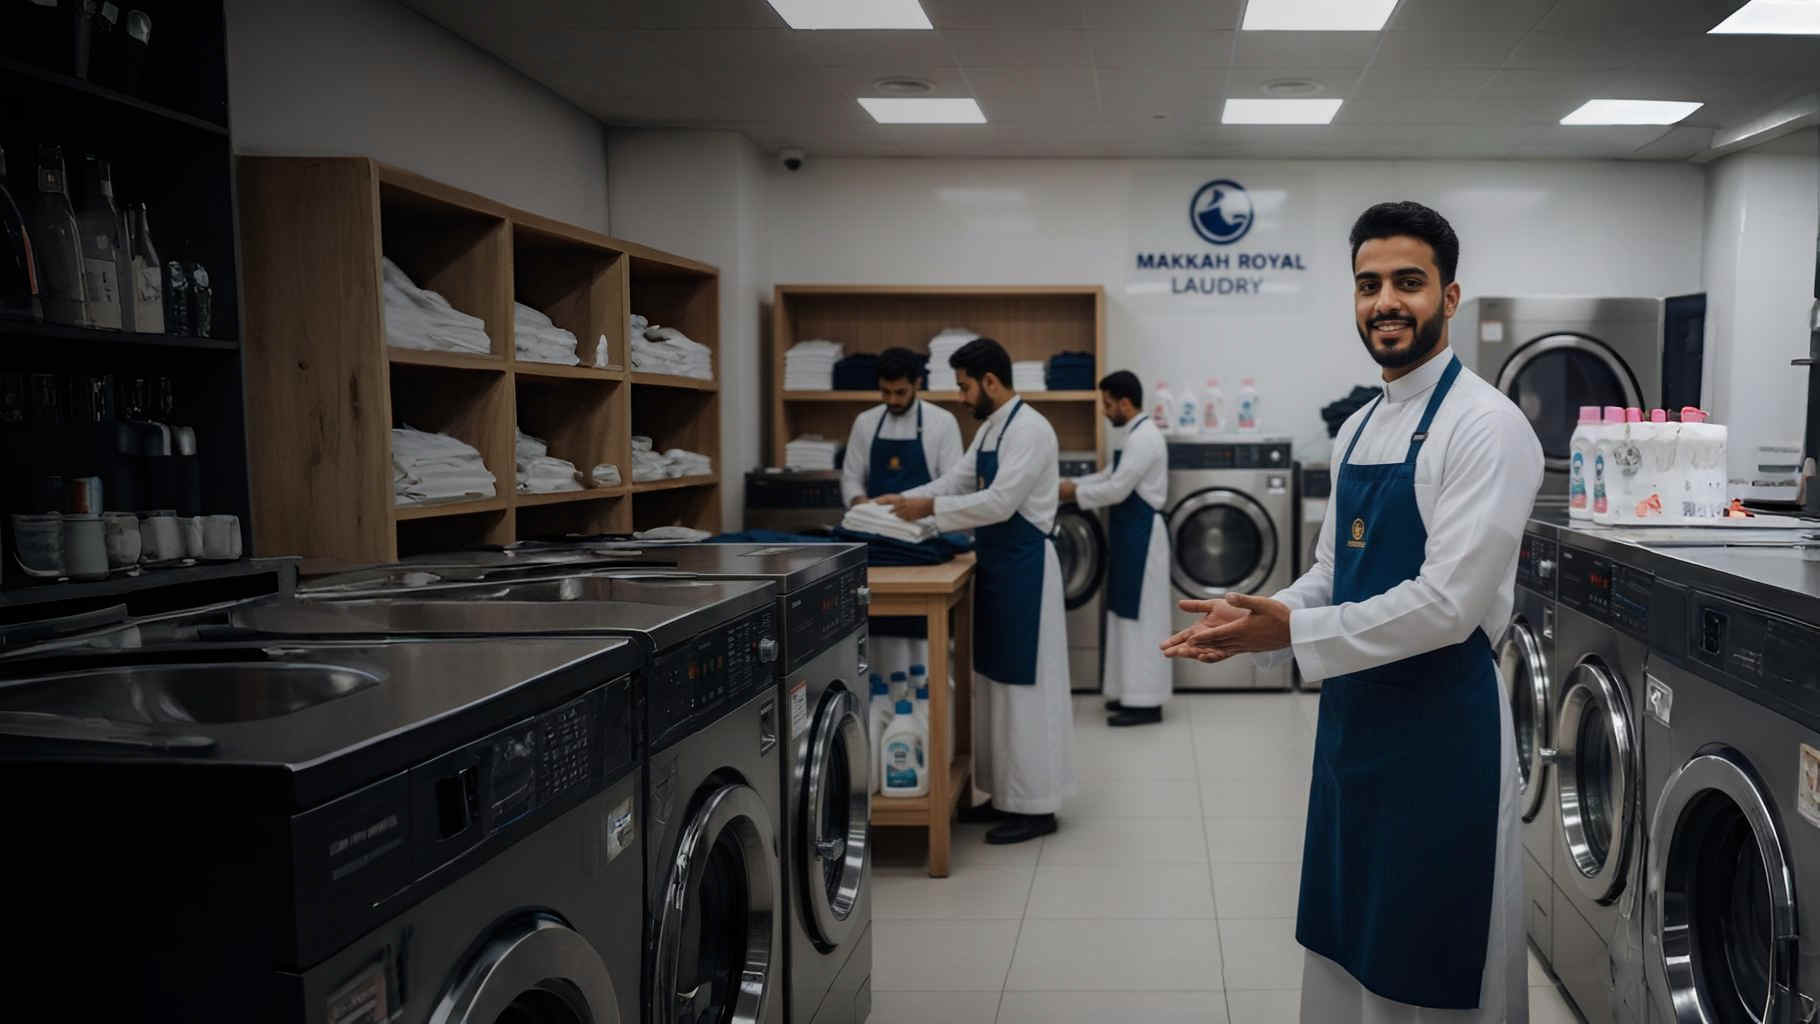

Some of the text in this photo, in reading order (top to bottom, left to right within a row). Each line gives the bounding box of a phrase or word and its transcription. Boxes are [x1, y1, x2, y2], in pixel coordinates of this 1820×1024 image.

[1137, 254, 1306, 270] MAKKAH ROYAL
[1171, 277, 1263, 295] LAUDRY
